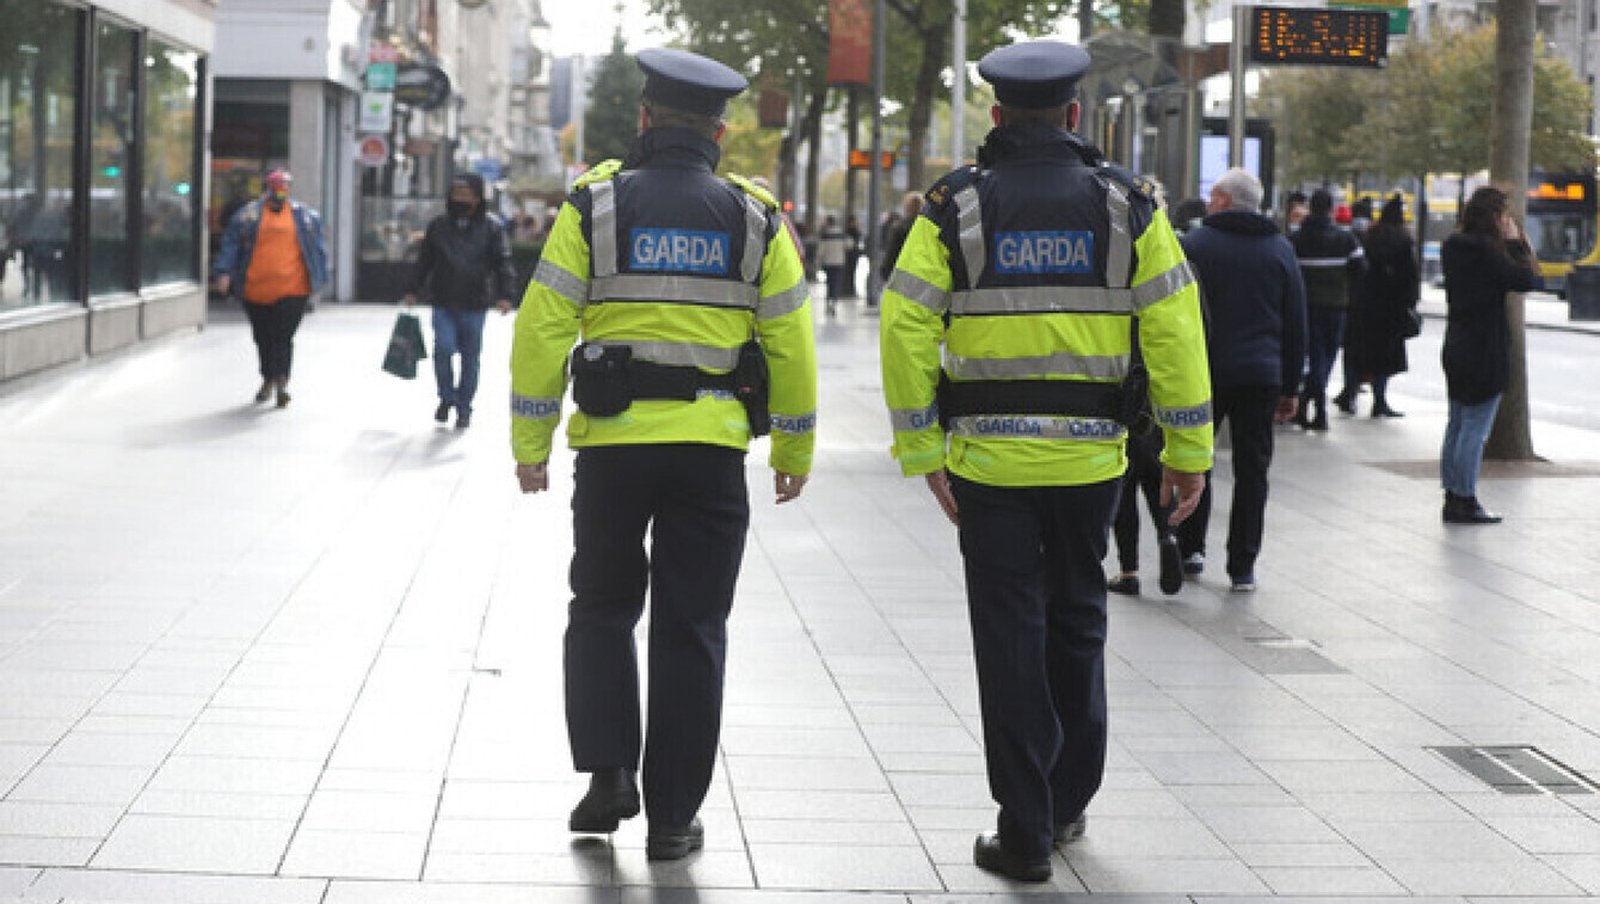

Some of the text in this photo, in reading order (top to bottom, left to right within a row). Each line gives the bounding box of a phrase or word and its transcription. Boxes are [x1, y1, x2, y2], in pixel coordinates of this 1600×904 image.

[634, 233, 724, 267] GARDA
[999, 237, 1089, 267] GARDA
[975, 418, 1041, 434] GARDA
